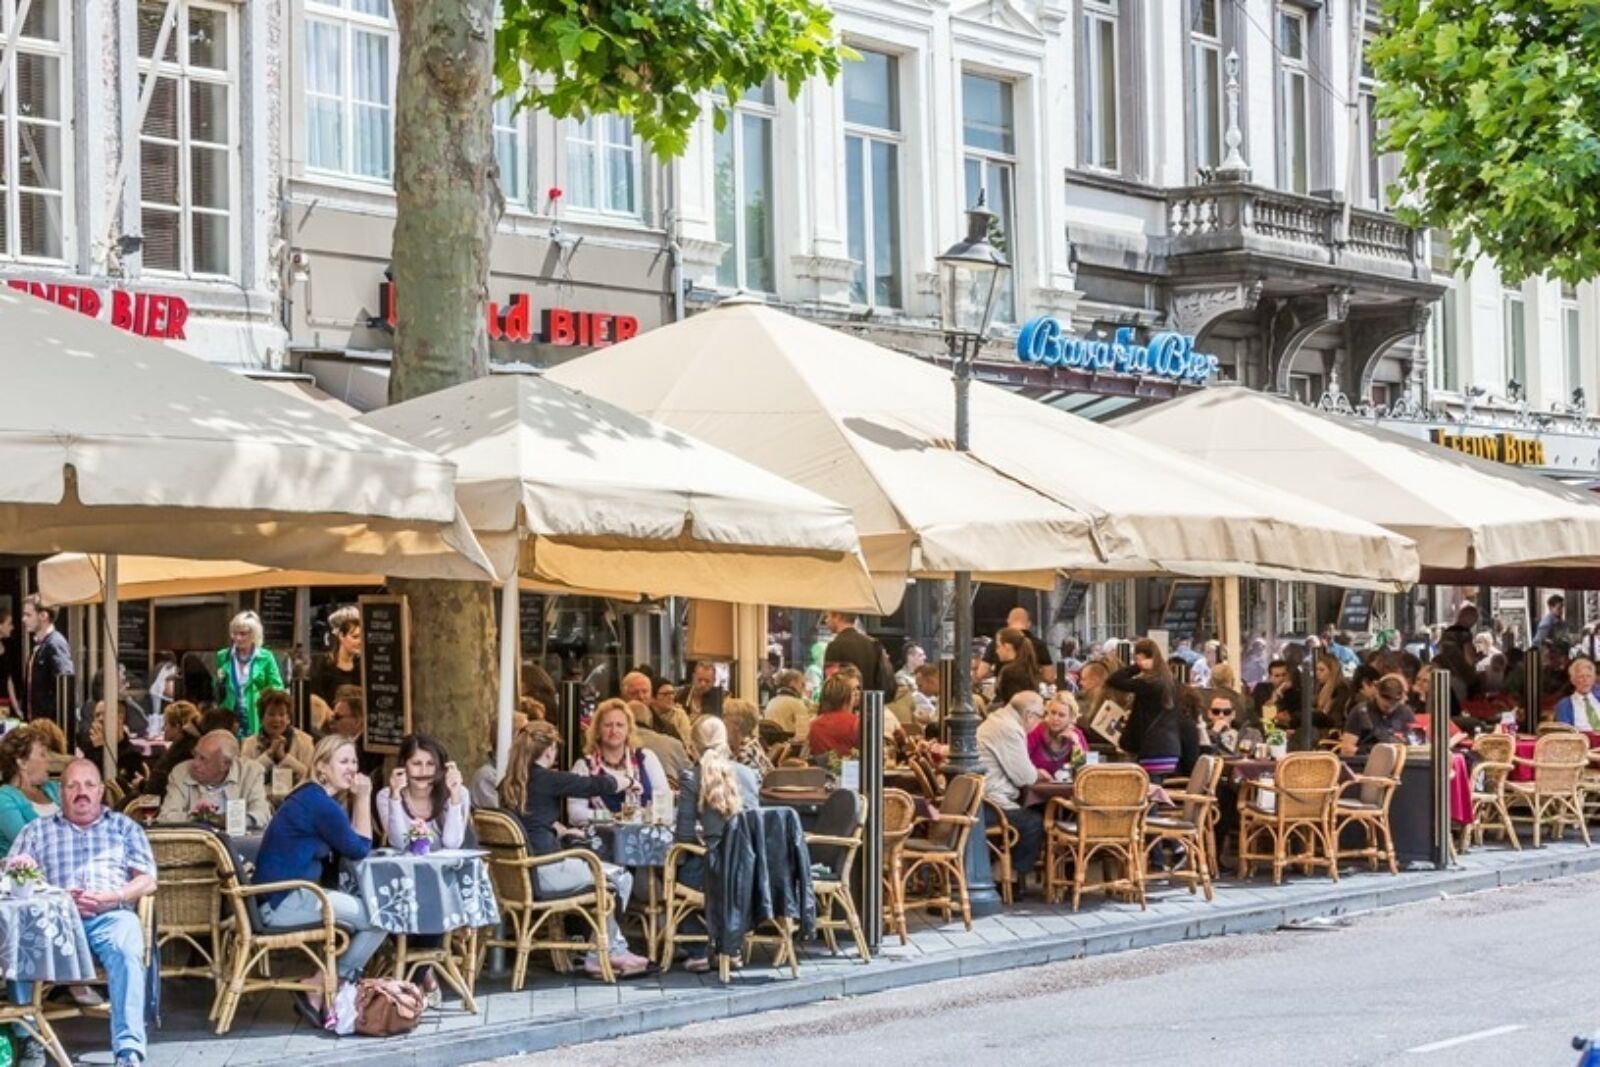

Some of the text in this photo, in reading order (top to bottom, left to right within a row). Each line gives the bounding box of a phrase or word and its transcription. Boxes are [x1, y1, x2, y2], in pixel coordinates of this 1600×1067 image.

[111, 289, 189, 340] BIER
[548, 308, 640, 347] BIER
[1017, 315, 1152, 374] Bavaria
